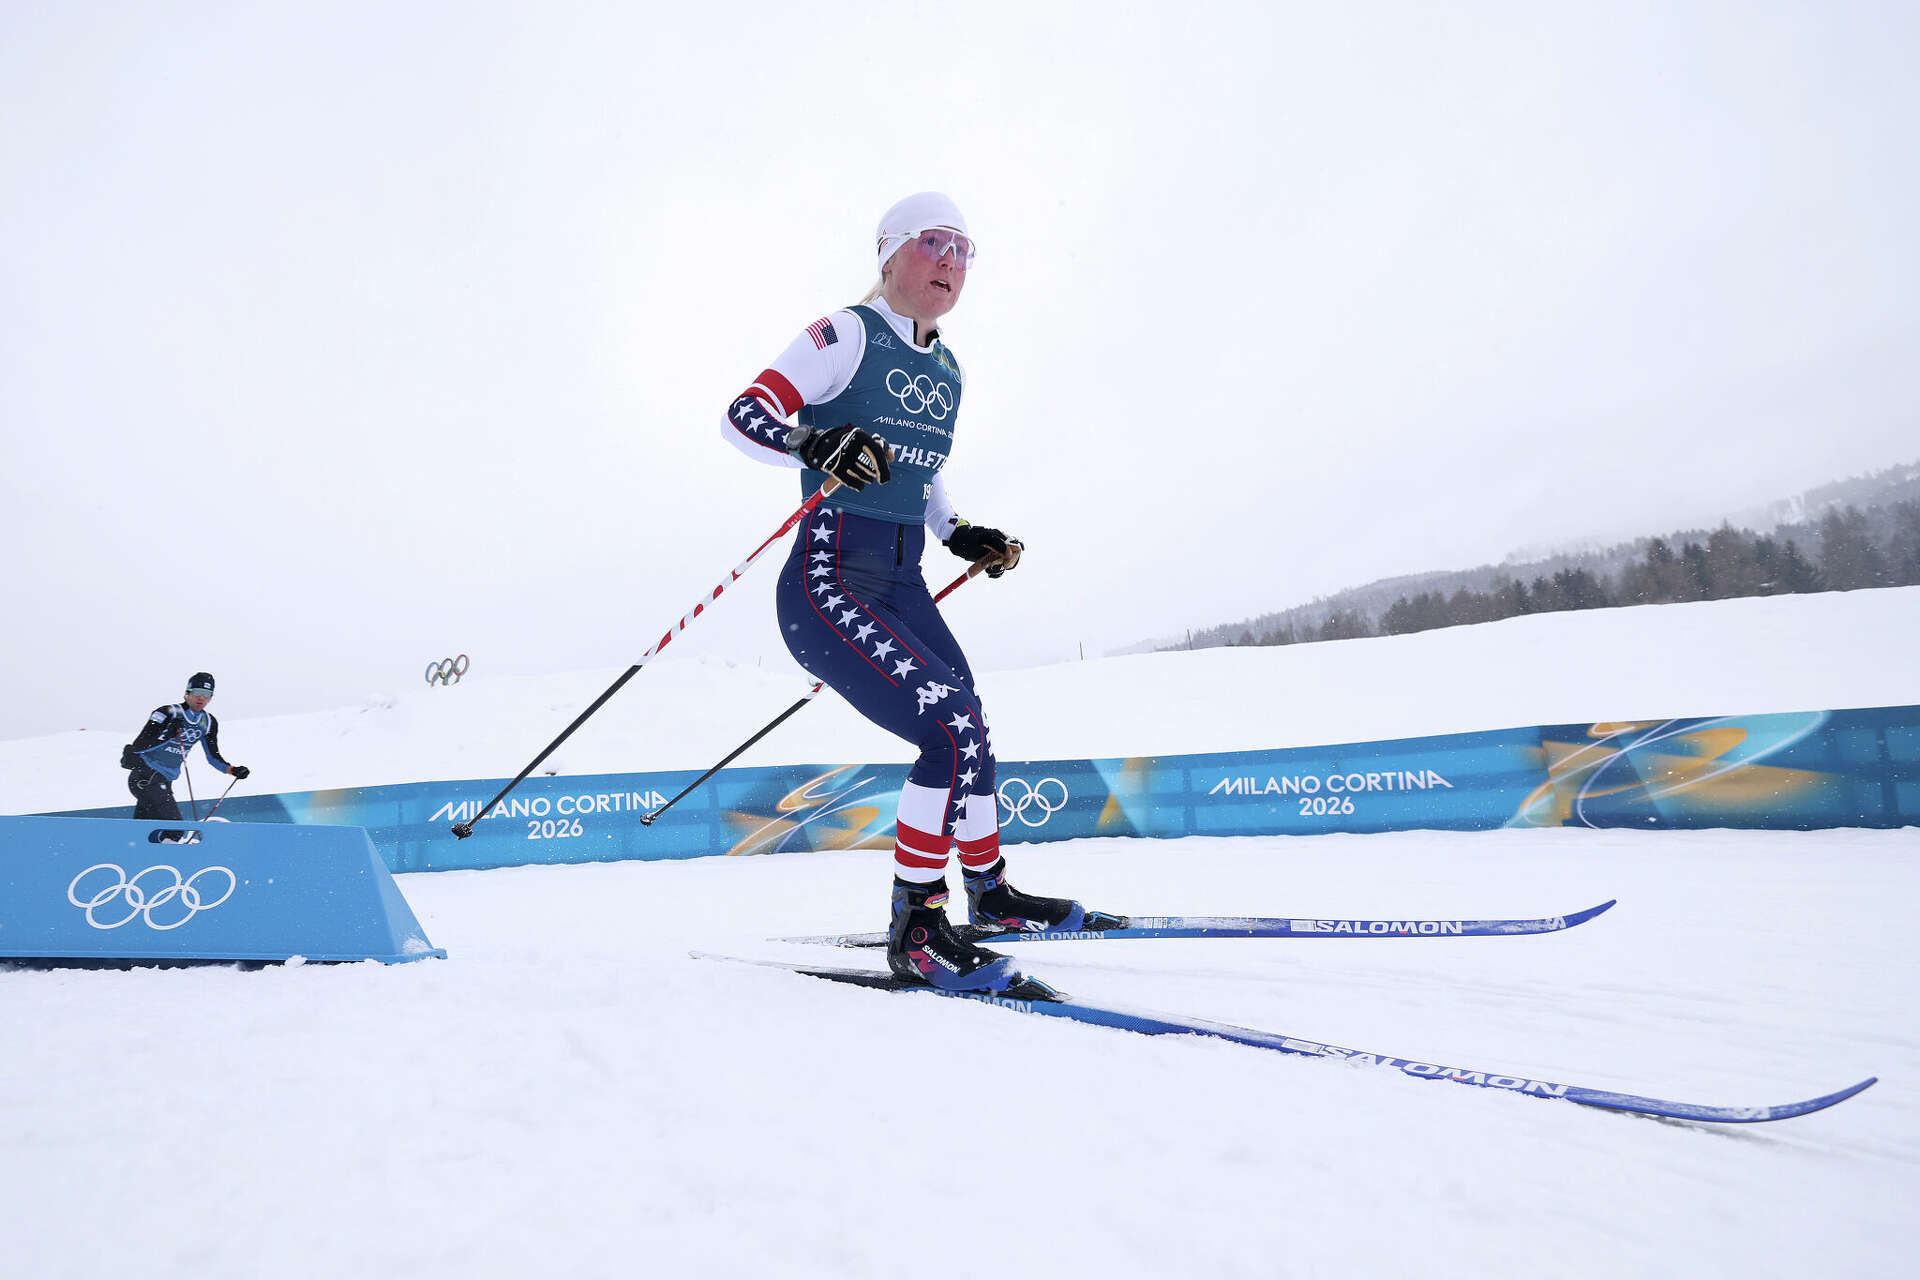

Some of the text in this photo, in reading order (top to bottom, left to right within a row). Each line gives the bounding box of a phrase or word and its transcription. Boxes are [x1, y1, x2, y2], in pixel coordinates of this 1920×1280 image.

[873, 415, 915, 428] MILANO
[916, 422, 947, 437] CORTINA
[887, 443, 948, 471] THLET
[1208, 769, 1455, 796] MILANO CORTINA
[428, 790, 674, 822] MILANO CORTINA
[1298, 796, 1355, 816] 2026
[527, 818, 584, 840] 2026
[1018, 930, 1105, 942] SALOMON
[1313, 920, 1463, 935] SALOMON
[921, 944, 961, 974] SALOMON
